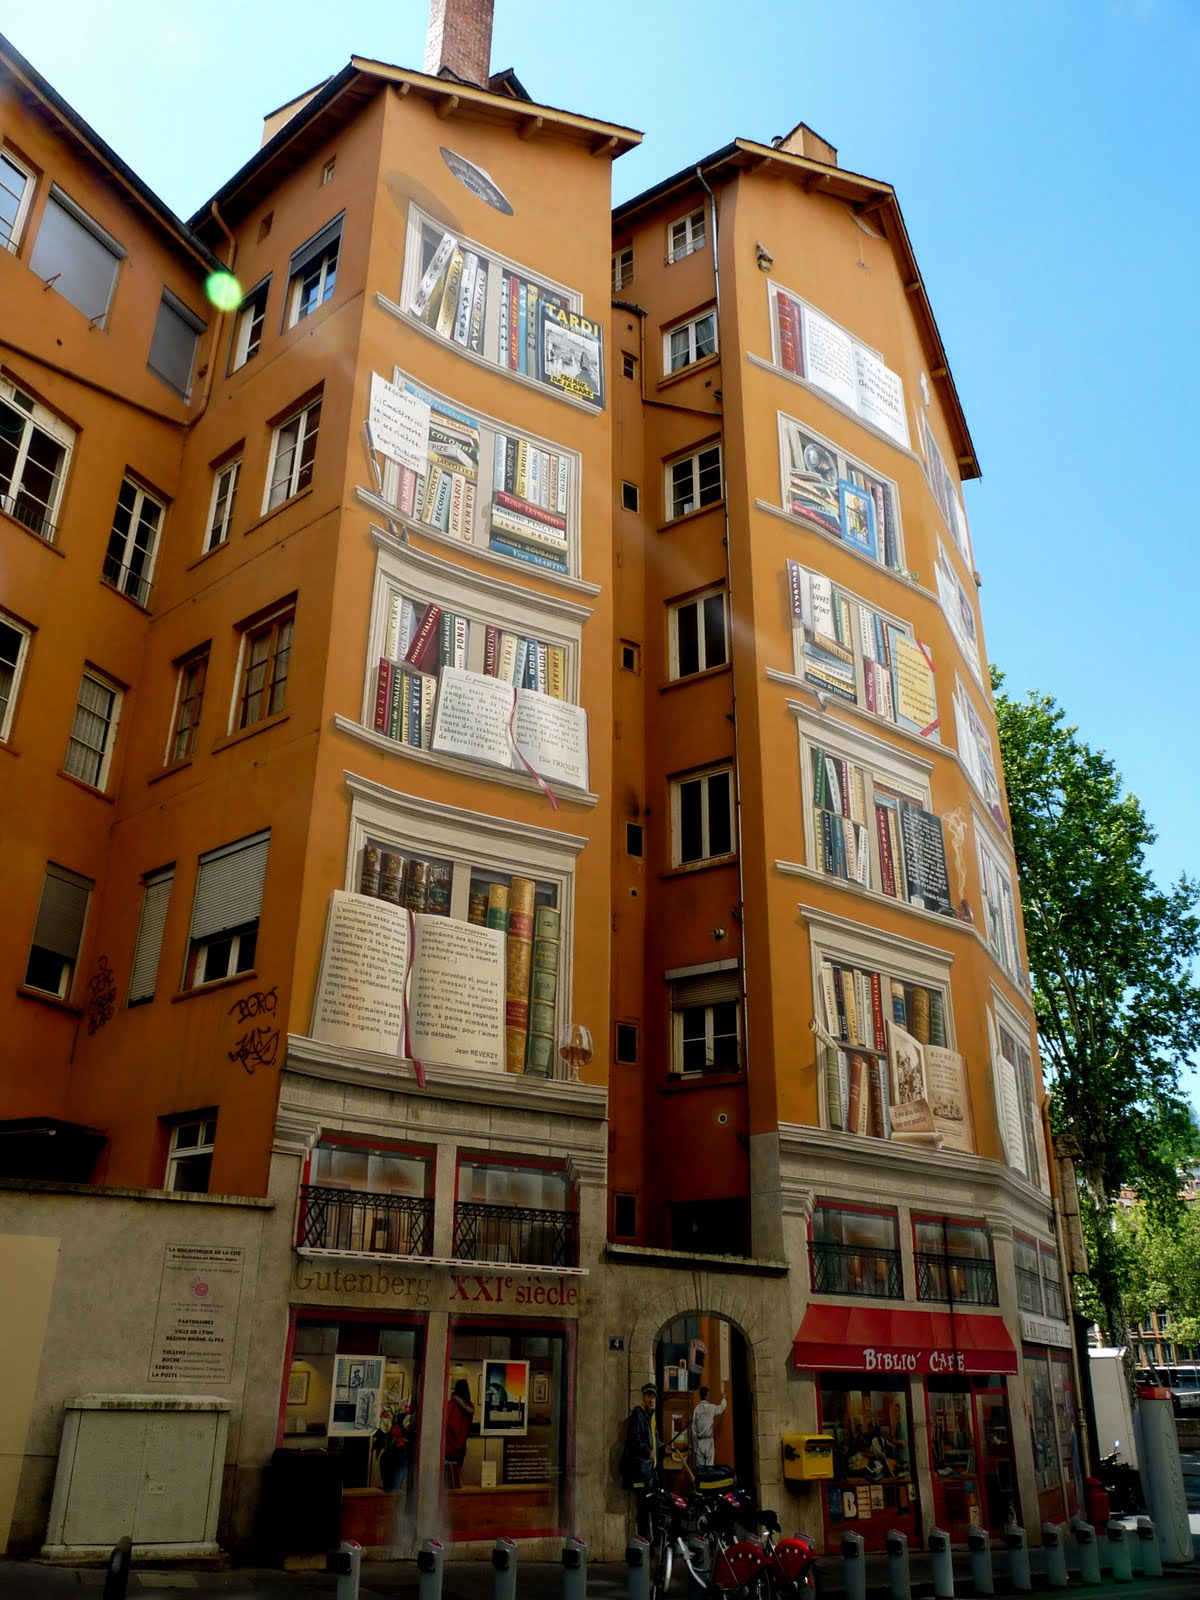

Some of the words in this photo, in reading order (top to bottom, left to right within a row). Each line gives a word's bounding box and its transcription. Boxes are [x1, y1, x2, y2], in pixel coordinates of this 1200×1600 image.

[459, 287, 469, 338] FAYARD
[544, 302, 600, 338] TARDI
[399, 422, 422, 438] ouverte
[507, 444, 515, 477] VERNET
[520, 442, 528, 481] TARDIEU
[416, 475, 426, 522] LAUPIN
[452, 479, 462, 532] BEURARD
[464, 486, 474, 541] CHAMBON
[500, 520, 522, 532] Jean
[525, 546, 560, 561] ROUBAUD
[512, 549, 530, 560] Yves
[533, 557, 567, 573] MARTIN
[812, 594, 829, 604] LIVRES
[403, 603, 411, 621] SUE
[420, 606, 439, 637] VIALATTE
[456, 620, 465, 650] PONGE
[539, 644, 547, 685] CLAUDEL
[393, 669, 401, 707] NOAILLES
[446, 682, 462, 690] Lyon
[445, 690, 474, 700] complice
[392, 711, 398, 720] de
[451, 705, 474, 716] bouche
[552, 759, 579, 773] TRIOLET
[367, 920, 379, 928] dont
[445, 1006, 471, 1015] nouveau
[473, 1011, 498, 1020] regarder
[472, 1002, 498, 1012] pouvions
[358, 1015, 381, 1023] comme
[384, 1020, 399, 1028] dans
[444, 1015, 463, 1023] peine
[384, 1029, 398, 1037] nous
[441, 1022, 460, 1032] bleue,
[462, 1027, 476, 1035] pour
[470, 1049, 498, 1059] REVERZY
[294, 1260, 431, 1305] Gutenberg
[515, 1276, 577, 1306] siècle
[613, 1339, 620, 1348] 4
